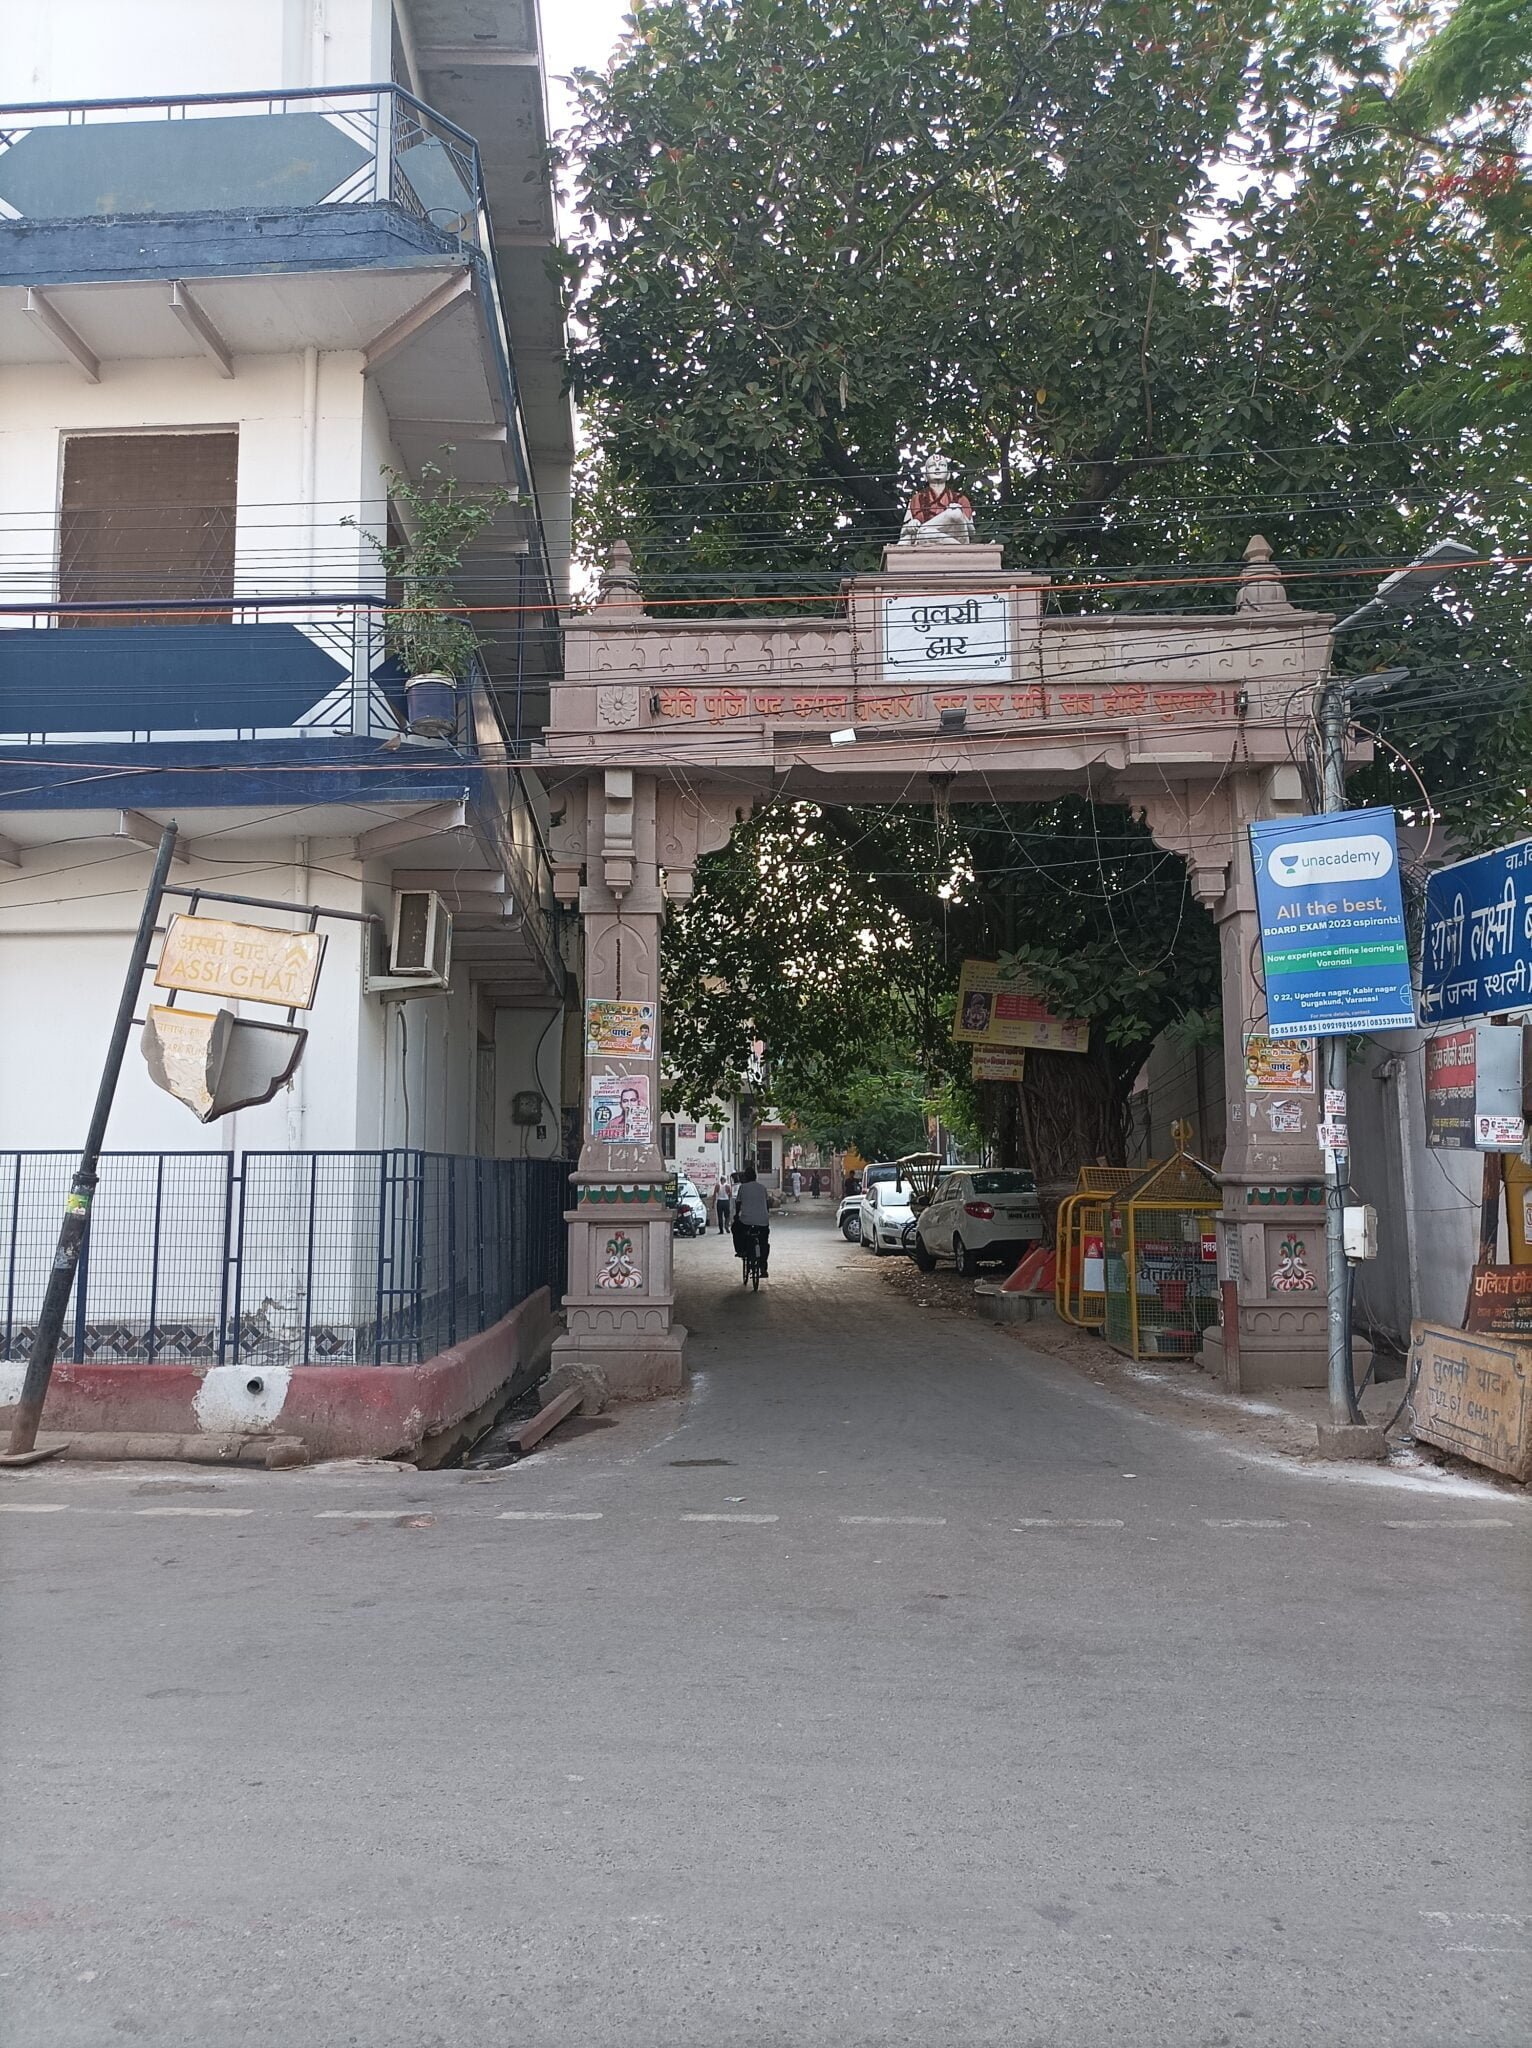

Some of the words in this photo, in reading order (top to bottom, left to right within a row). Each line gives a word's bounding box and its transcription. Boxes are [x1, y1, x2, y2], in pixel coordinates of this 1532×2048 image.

[910, 599, 982, 632] तुलसी
[925, 636, 969, 659] द्वार
[659, 688, 698, 717] देवि
[754, 696, 785, 719] पद
[792, 696, 848, 717] कमल
[973, 694, 1005, 717] नर
[1059, 693, 1096, 716] सब
[1301, 850, 1380, 868] unacademy
[1277, 902, 1300, 920] All
[1306, 901, 1337, 916] the
[1343, 897, 1387, 913] best,
[1264, 925, 1297, 936] BOARD
[1300, 921, 1328, 932] EXAM
[1328, 919, 1352, 929] 2023
[1353, 914, 1401, 928] aspirants!
[1431, 893, 1465, 971] रानी
[1471, 876, 1517, 962] लक्ष्मी
[1267, 954, 1286, 963] Now
[1287, 950, 1332, 961] experience
[1333, 946, 1359, 956] offline
[1361, 944, 1394, 954] learning
[1396, 943, 1404, 951] in
[1316, 957, 1352, 967] Varanasi
[171, 959, 222, 983] ASSI
[230, 965, 298, 993] GHAT
[1294, 990, 1326, 1000] Upendra
[1328, 988, 1352, 998] nagar,
[1353, 986, 1373, 995] Kabir
[1375, 985, 1398, 994] nagar
[1301, 998, 1344, 1008] Durgakund,
[1346, 995, 1378, 1004] Varanasi
[1475, 1271, 1510, 1297] पुलिस
[1433, 1354, 1470, 1386] तुलसी
[1475, 1367, 1503, 1393] घाट
[1428, 1387, 1462, 1415] TULSI
[1467, 1400, 1499, 1427] GHAT
